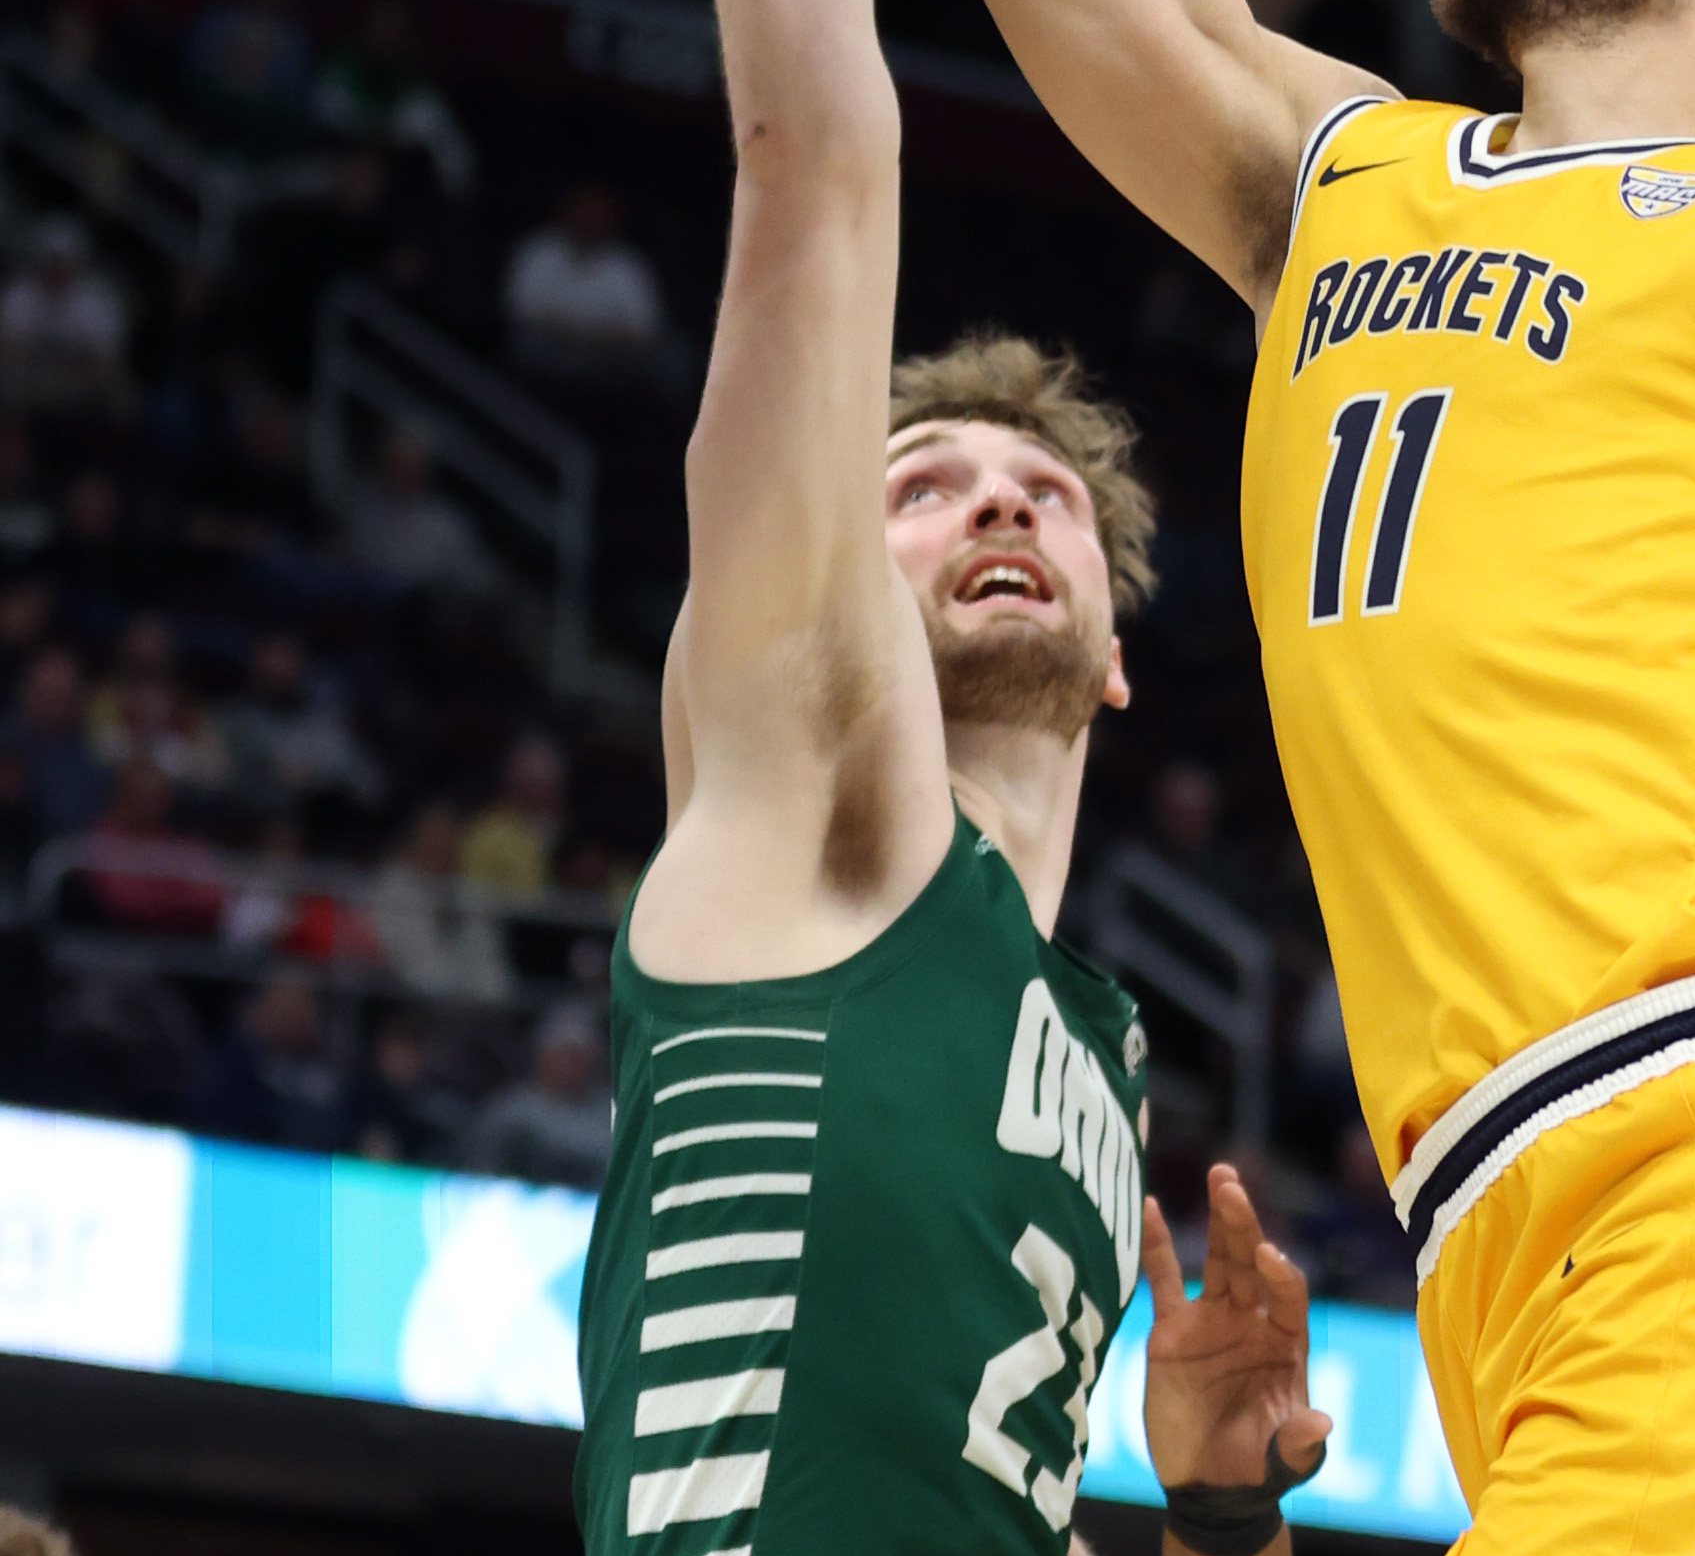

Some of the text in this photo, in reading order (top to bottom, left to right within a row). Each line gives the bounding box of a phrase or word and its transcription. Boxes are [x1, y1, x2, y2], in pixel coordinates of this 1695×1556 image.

[1290, 245, 1588, 386] ROCKETS
[1307, 385, 1454, 629] 11
[996, 977, 1142, 1310] OHIO
